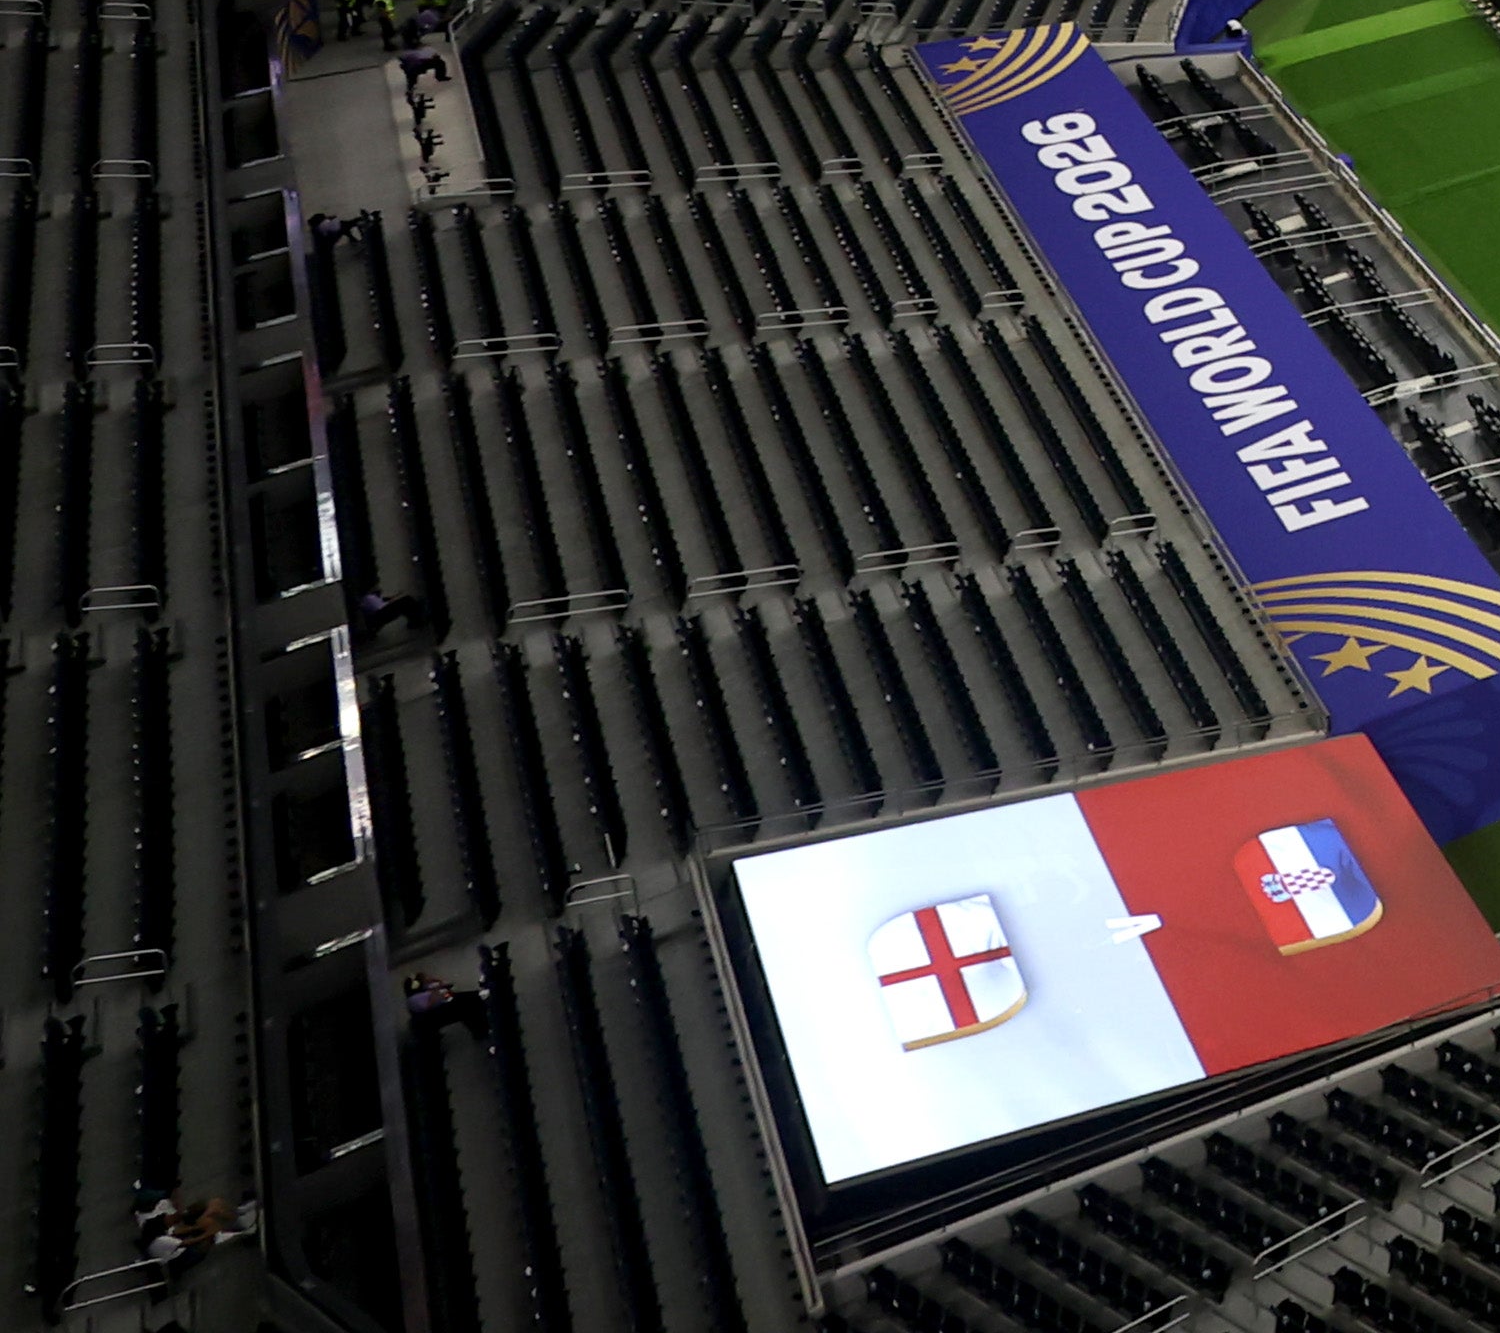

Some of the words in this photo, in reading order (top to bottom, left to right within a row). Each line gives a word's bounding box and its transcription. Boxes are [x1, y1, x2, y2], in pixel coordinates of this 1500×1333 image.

[1021, 112, 1155, 222] 2026
[1093, 225, 1200, 290] CUP
[1143, 287, 1298, 436] WORLD
[1236, 420, 1370, 533] FIFA
